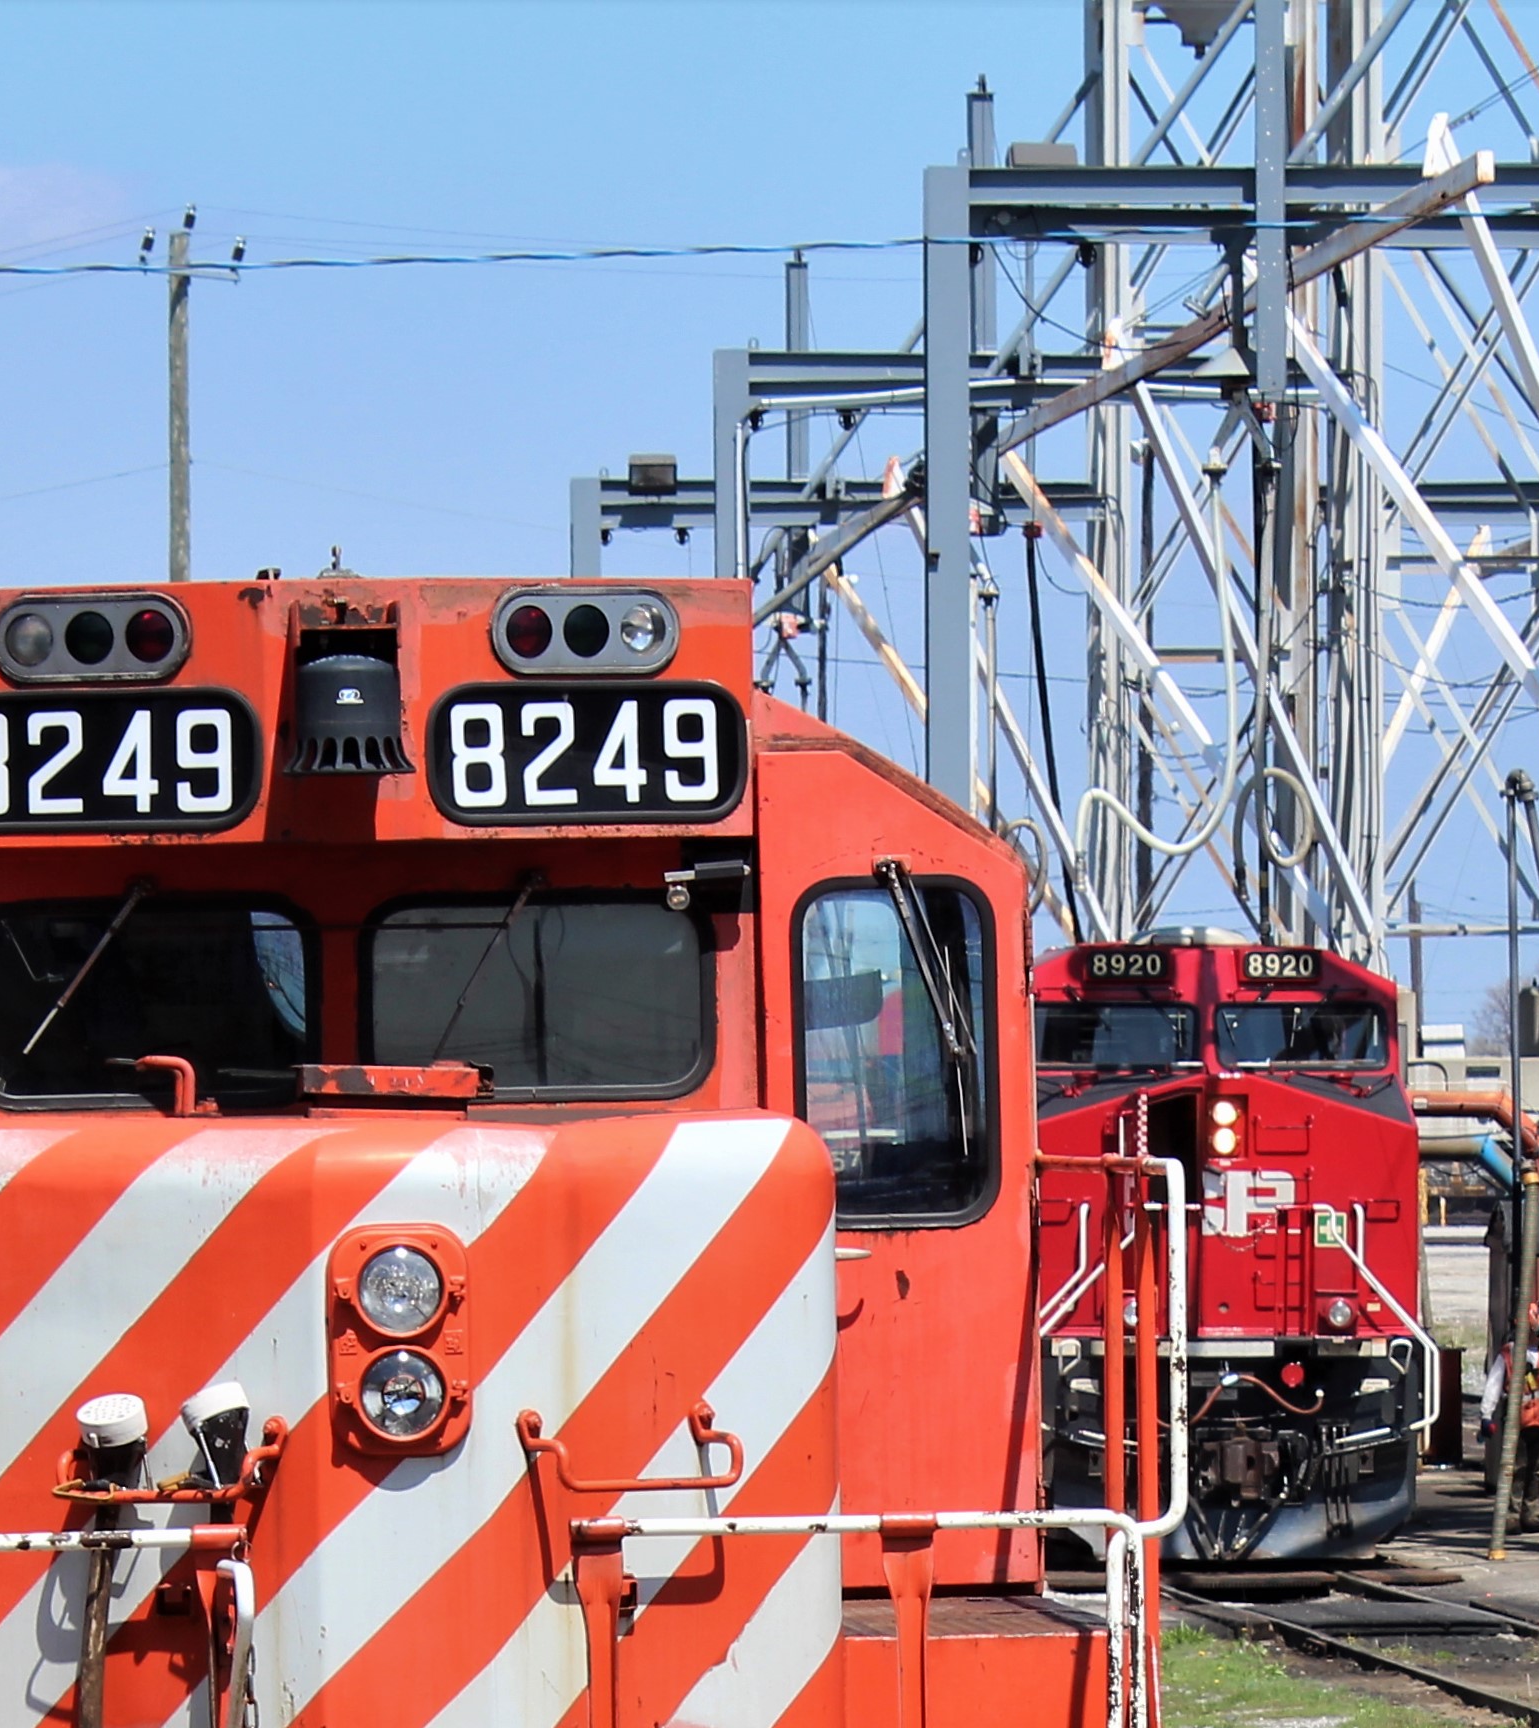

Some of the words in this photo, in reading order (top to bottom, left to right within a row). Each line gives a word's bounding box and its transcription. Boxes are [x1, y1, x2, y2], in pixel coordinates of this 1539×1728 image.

[449, 697, 719, 809] 8249
[1092, 953, 1162, 976] 8920
[1248, 953, 1313, 977] 8920
